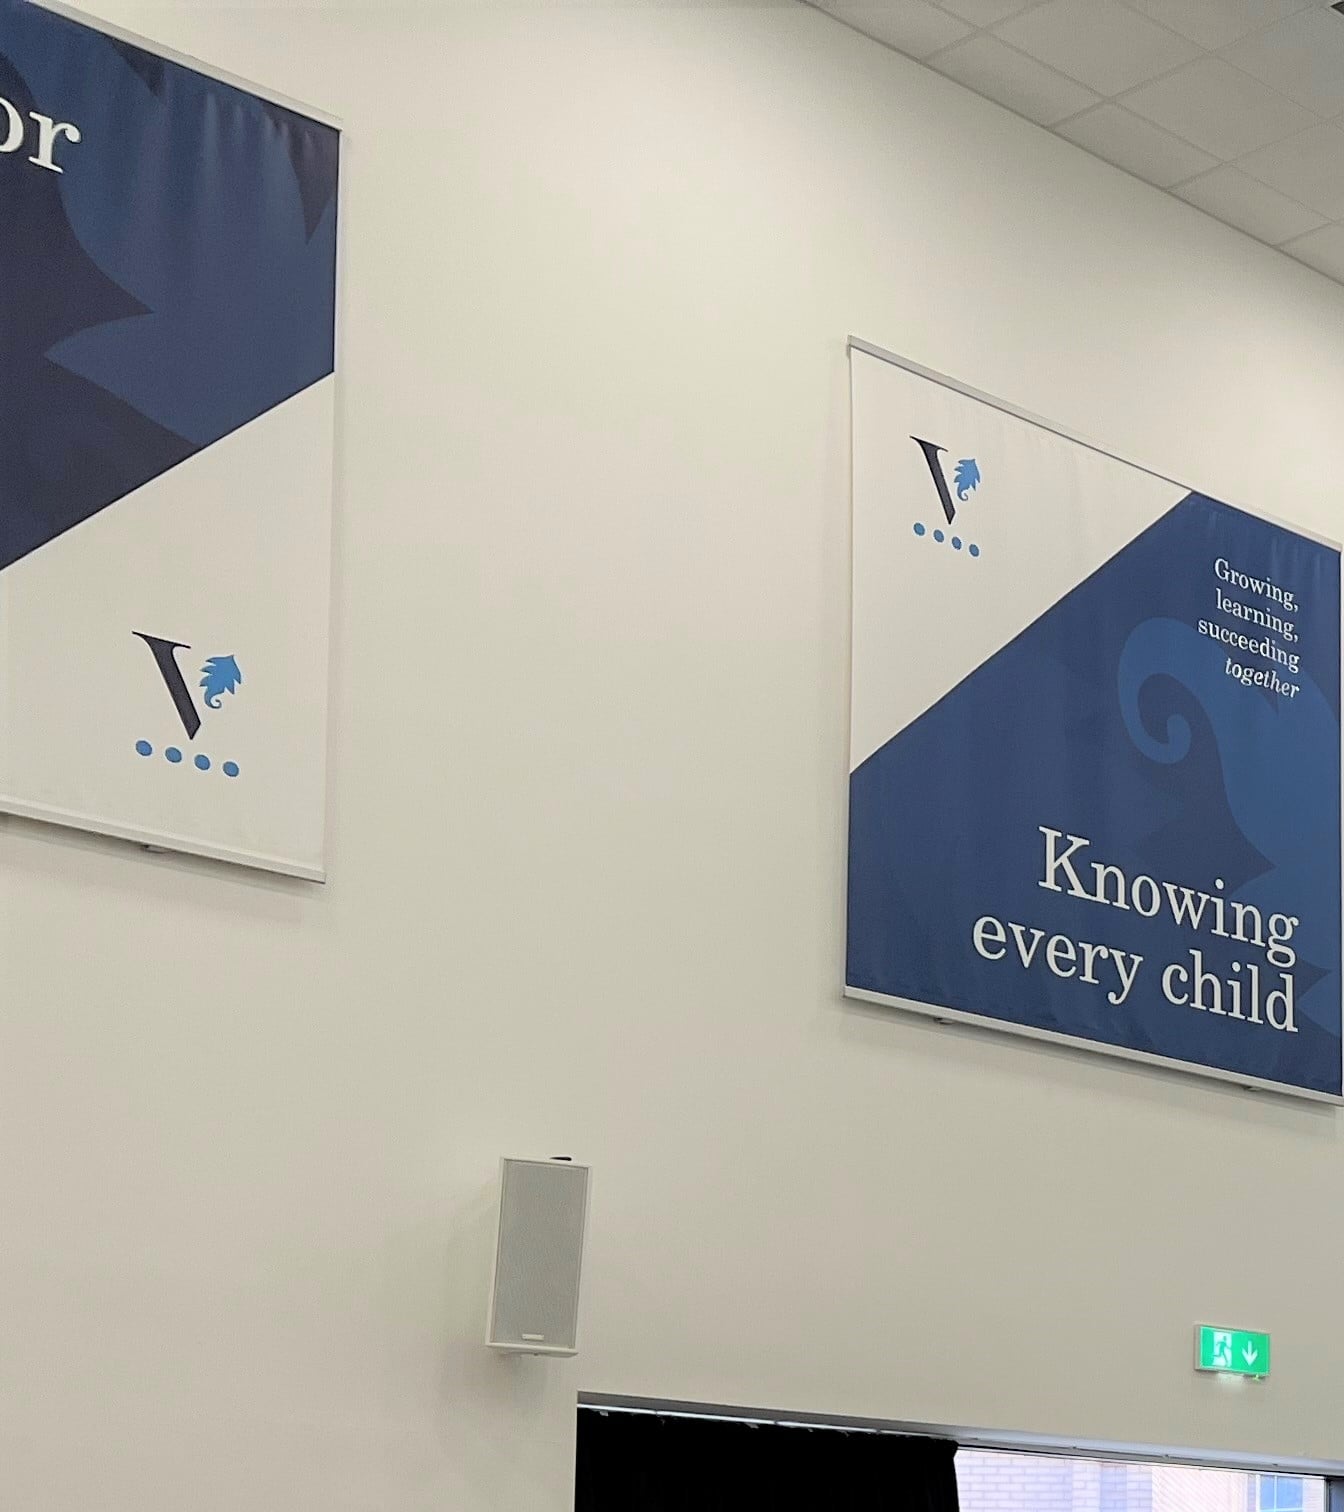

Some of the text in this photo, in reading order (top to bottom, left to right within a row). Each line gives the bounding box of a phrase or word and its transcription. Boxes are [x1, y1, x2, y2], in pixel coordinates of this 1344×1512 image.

[1214, 558, 1298, 613] Growing,
[1216, 587, 1298, 643] learning,
[1198, 619, 1300, 674] succeeding
[1225, 657, 1300, 698] together
[1038, 825, 1299, 968] Knowing
[972, 915, 1298, 1033] every child
